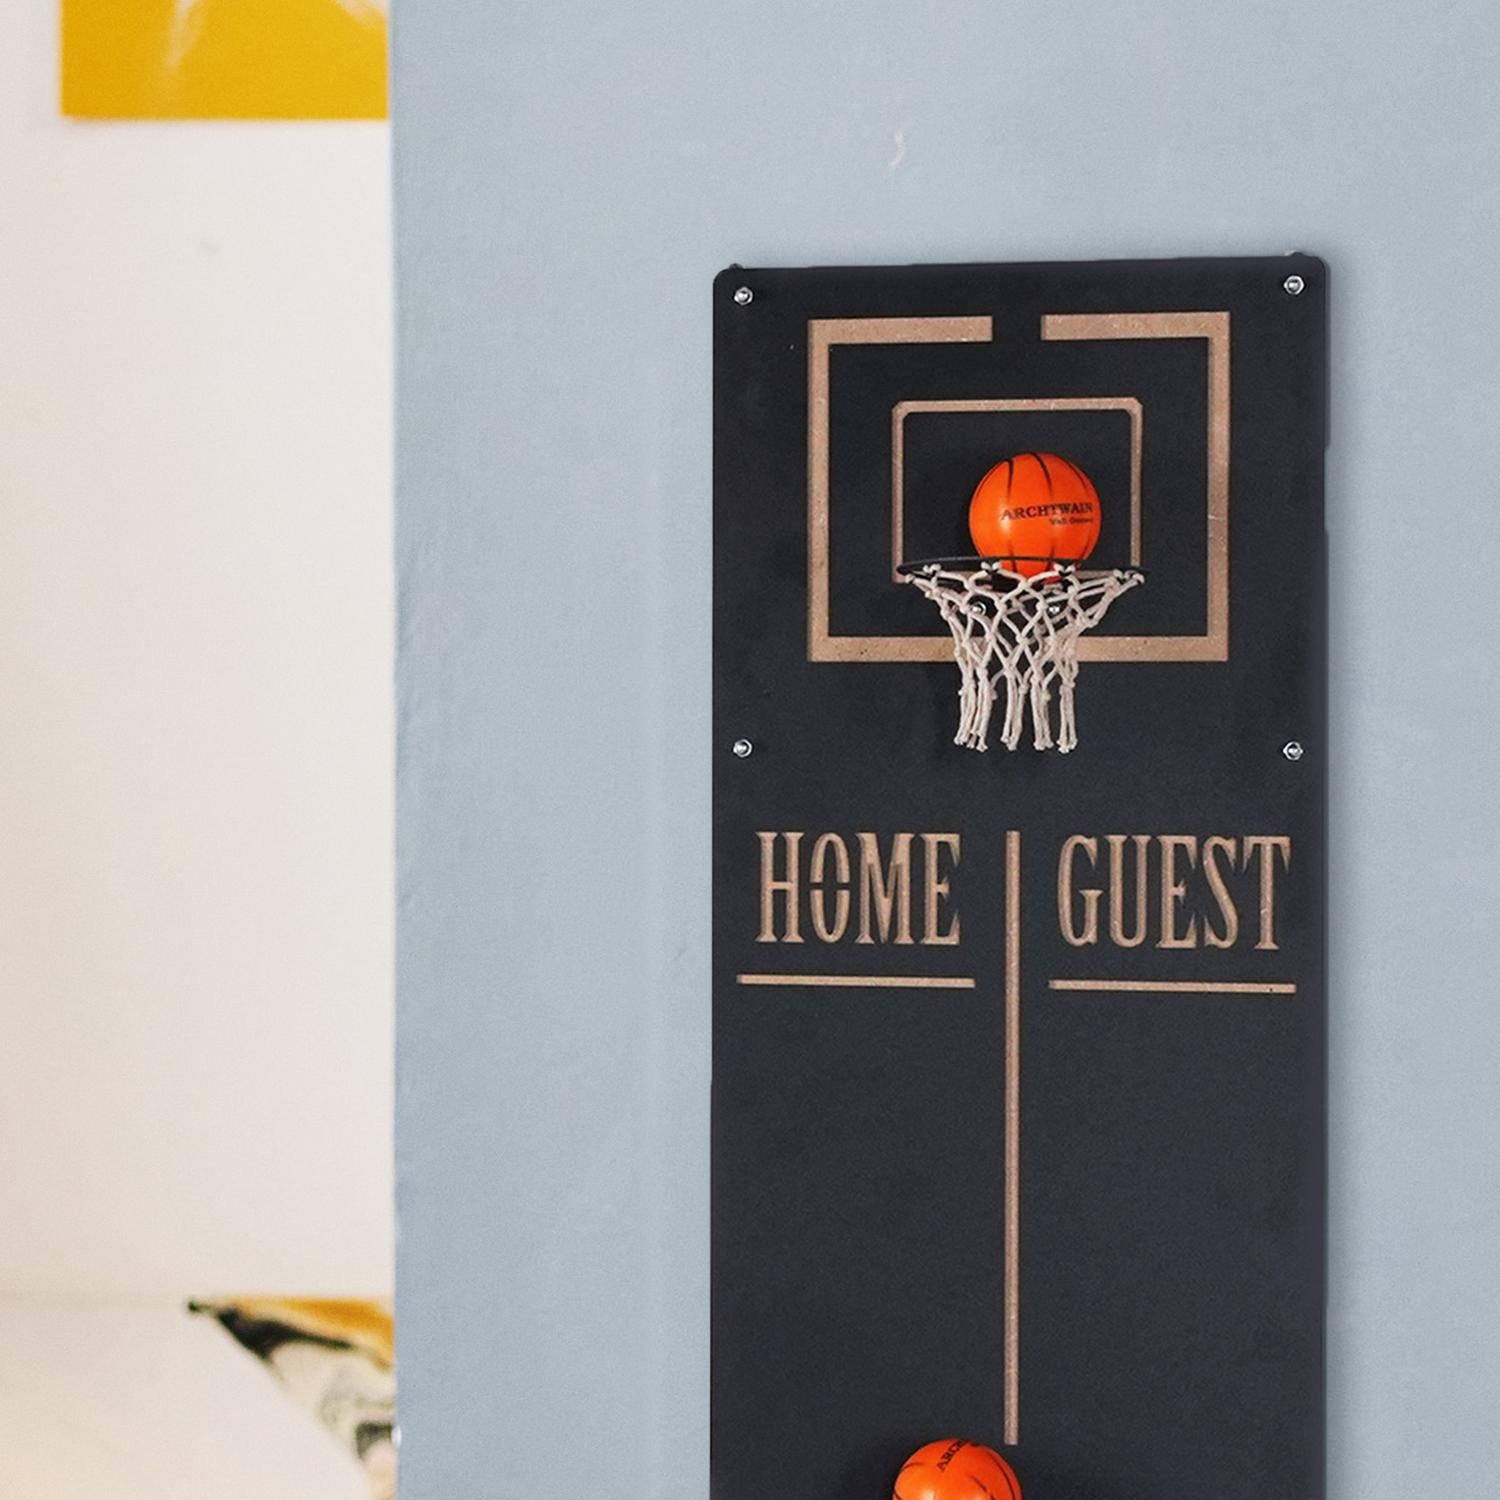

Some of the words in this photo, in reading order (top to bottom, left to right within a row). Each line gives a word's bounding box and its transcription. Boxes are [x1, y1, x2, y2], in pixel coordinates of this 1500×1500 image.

[1000, 502, 1094, 521] ARCHTWAIN
[754, 830, 961, 945] HOME
[1056, 833, 1292, 950] GUEST
